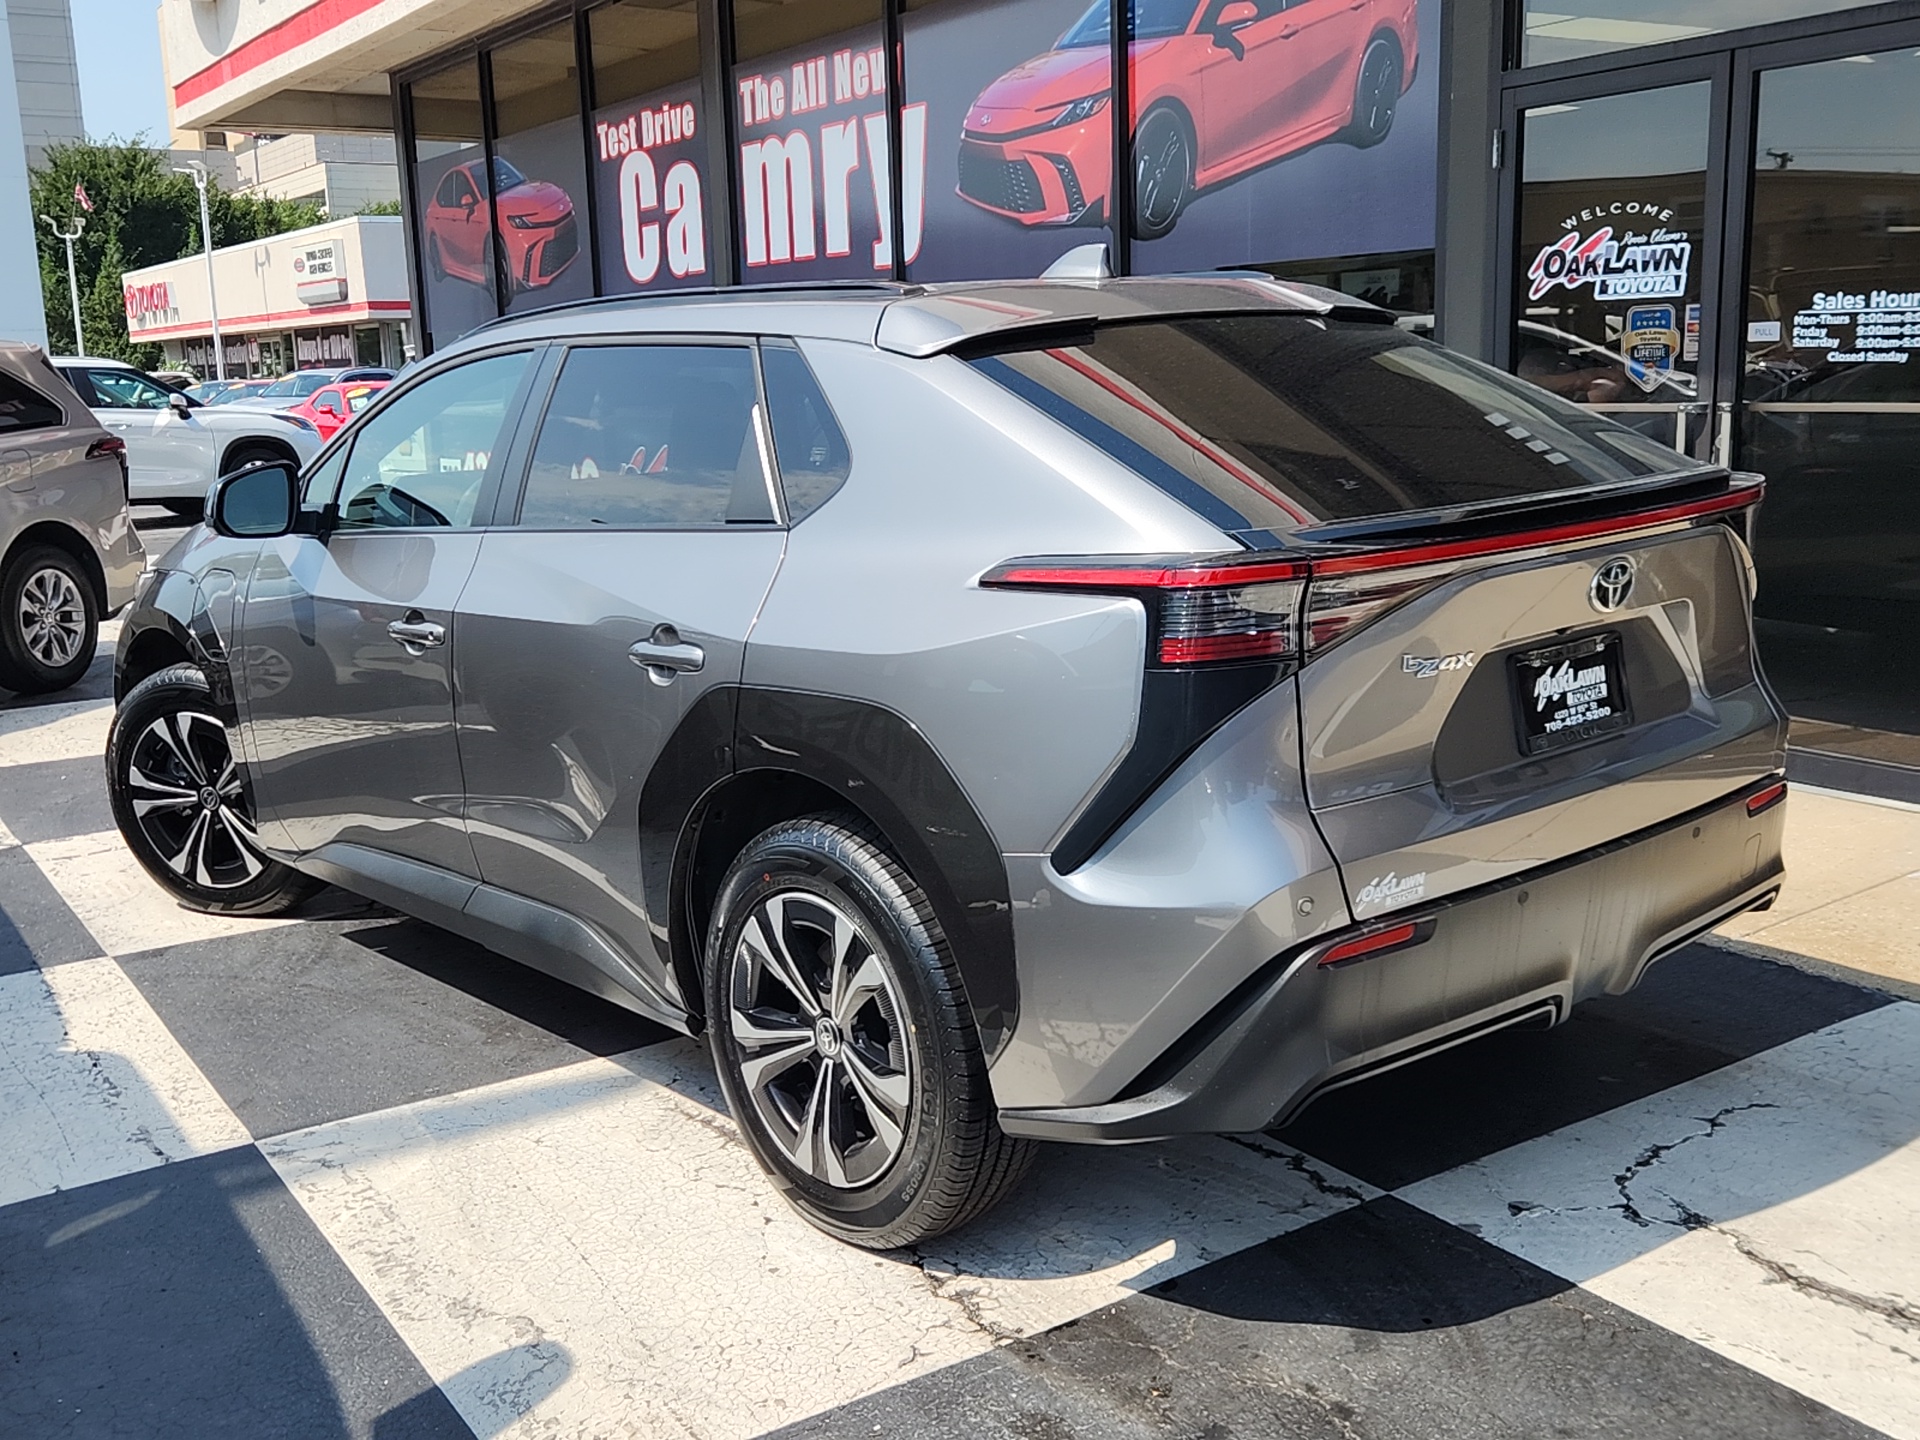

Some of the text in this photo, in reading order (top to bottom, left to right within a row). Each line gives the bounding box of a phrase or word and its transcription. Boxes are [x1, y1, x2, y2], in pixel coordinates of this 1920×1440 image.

[739, 75, 785, 126] The
[791, 56, 828, 115] All
[597, 101, 695, 161] Test Drive
[1560, 202, 1674, 230] WELCOME
[1605, 276, 1676, 295] TOYOTA
[136, 281, 171, 313] TOYOTA
[1812, 291, 1866, 310] Sales
[1794, 314, 1850, 325] Mon-Thurs
[1755, 327, 1773, 336] PULL
[1793, 326, 1828, 337] Friday
[1792, 337, 1840, 348] Saturday
[1634, 348, 1666, 358] LIFETIME
[1827, 351, 1909, 363] Closed Sunday
[1571, 685, 1603, 702] TOYOTA
[1390, 888, 1419, 902] TOYOTA
